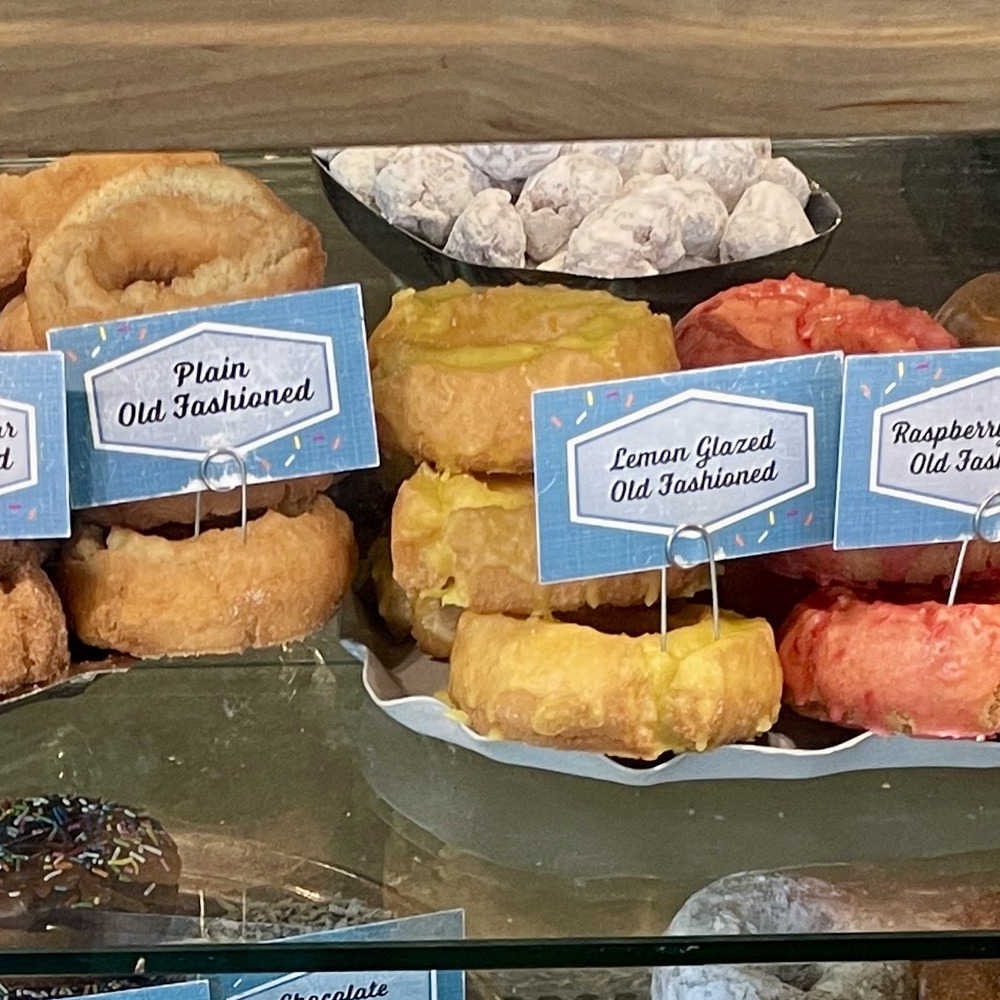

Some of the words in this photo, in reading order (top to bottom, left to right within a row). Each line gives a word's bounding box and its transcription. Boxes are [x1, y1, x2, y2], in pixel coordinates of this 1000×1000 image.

[173, 358, 250, 388] Plain
[118, 400, 165, 427] Old
[173, 379, 314, 420] Fashioned
[609, 447, 689, 471] Lemon
[696, 429, 776, 468] Glazed
[910, 452, 951, 474] Old
[610, 480, 652, 503] Old
[659, 461, 778, 496] Fashioned
